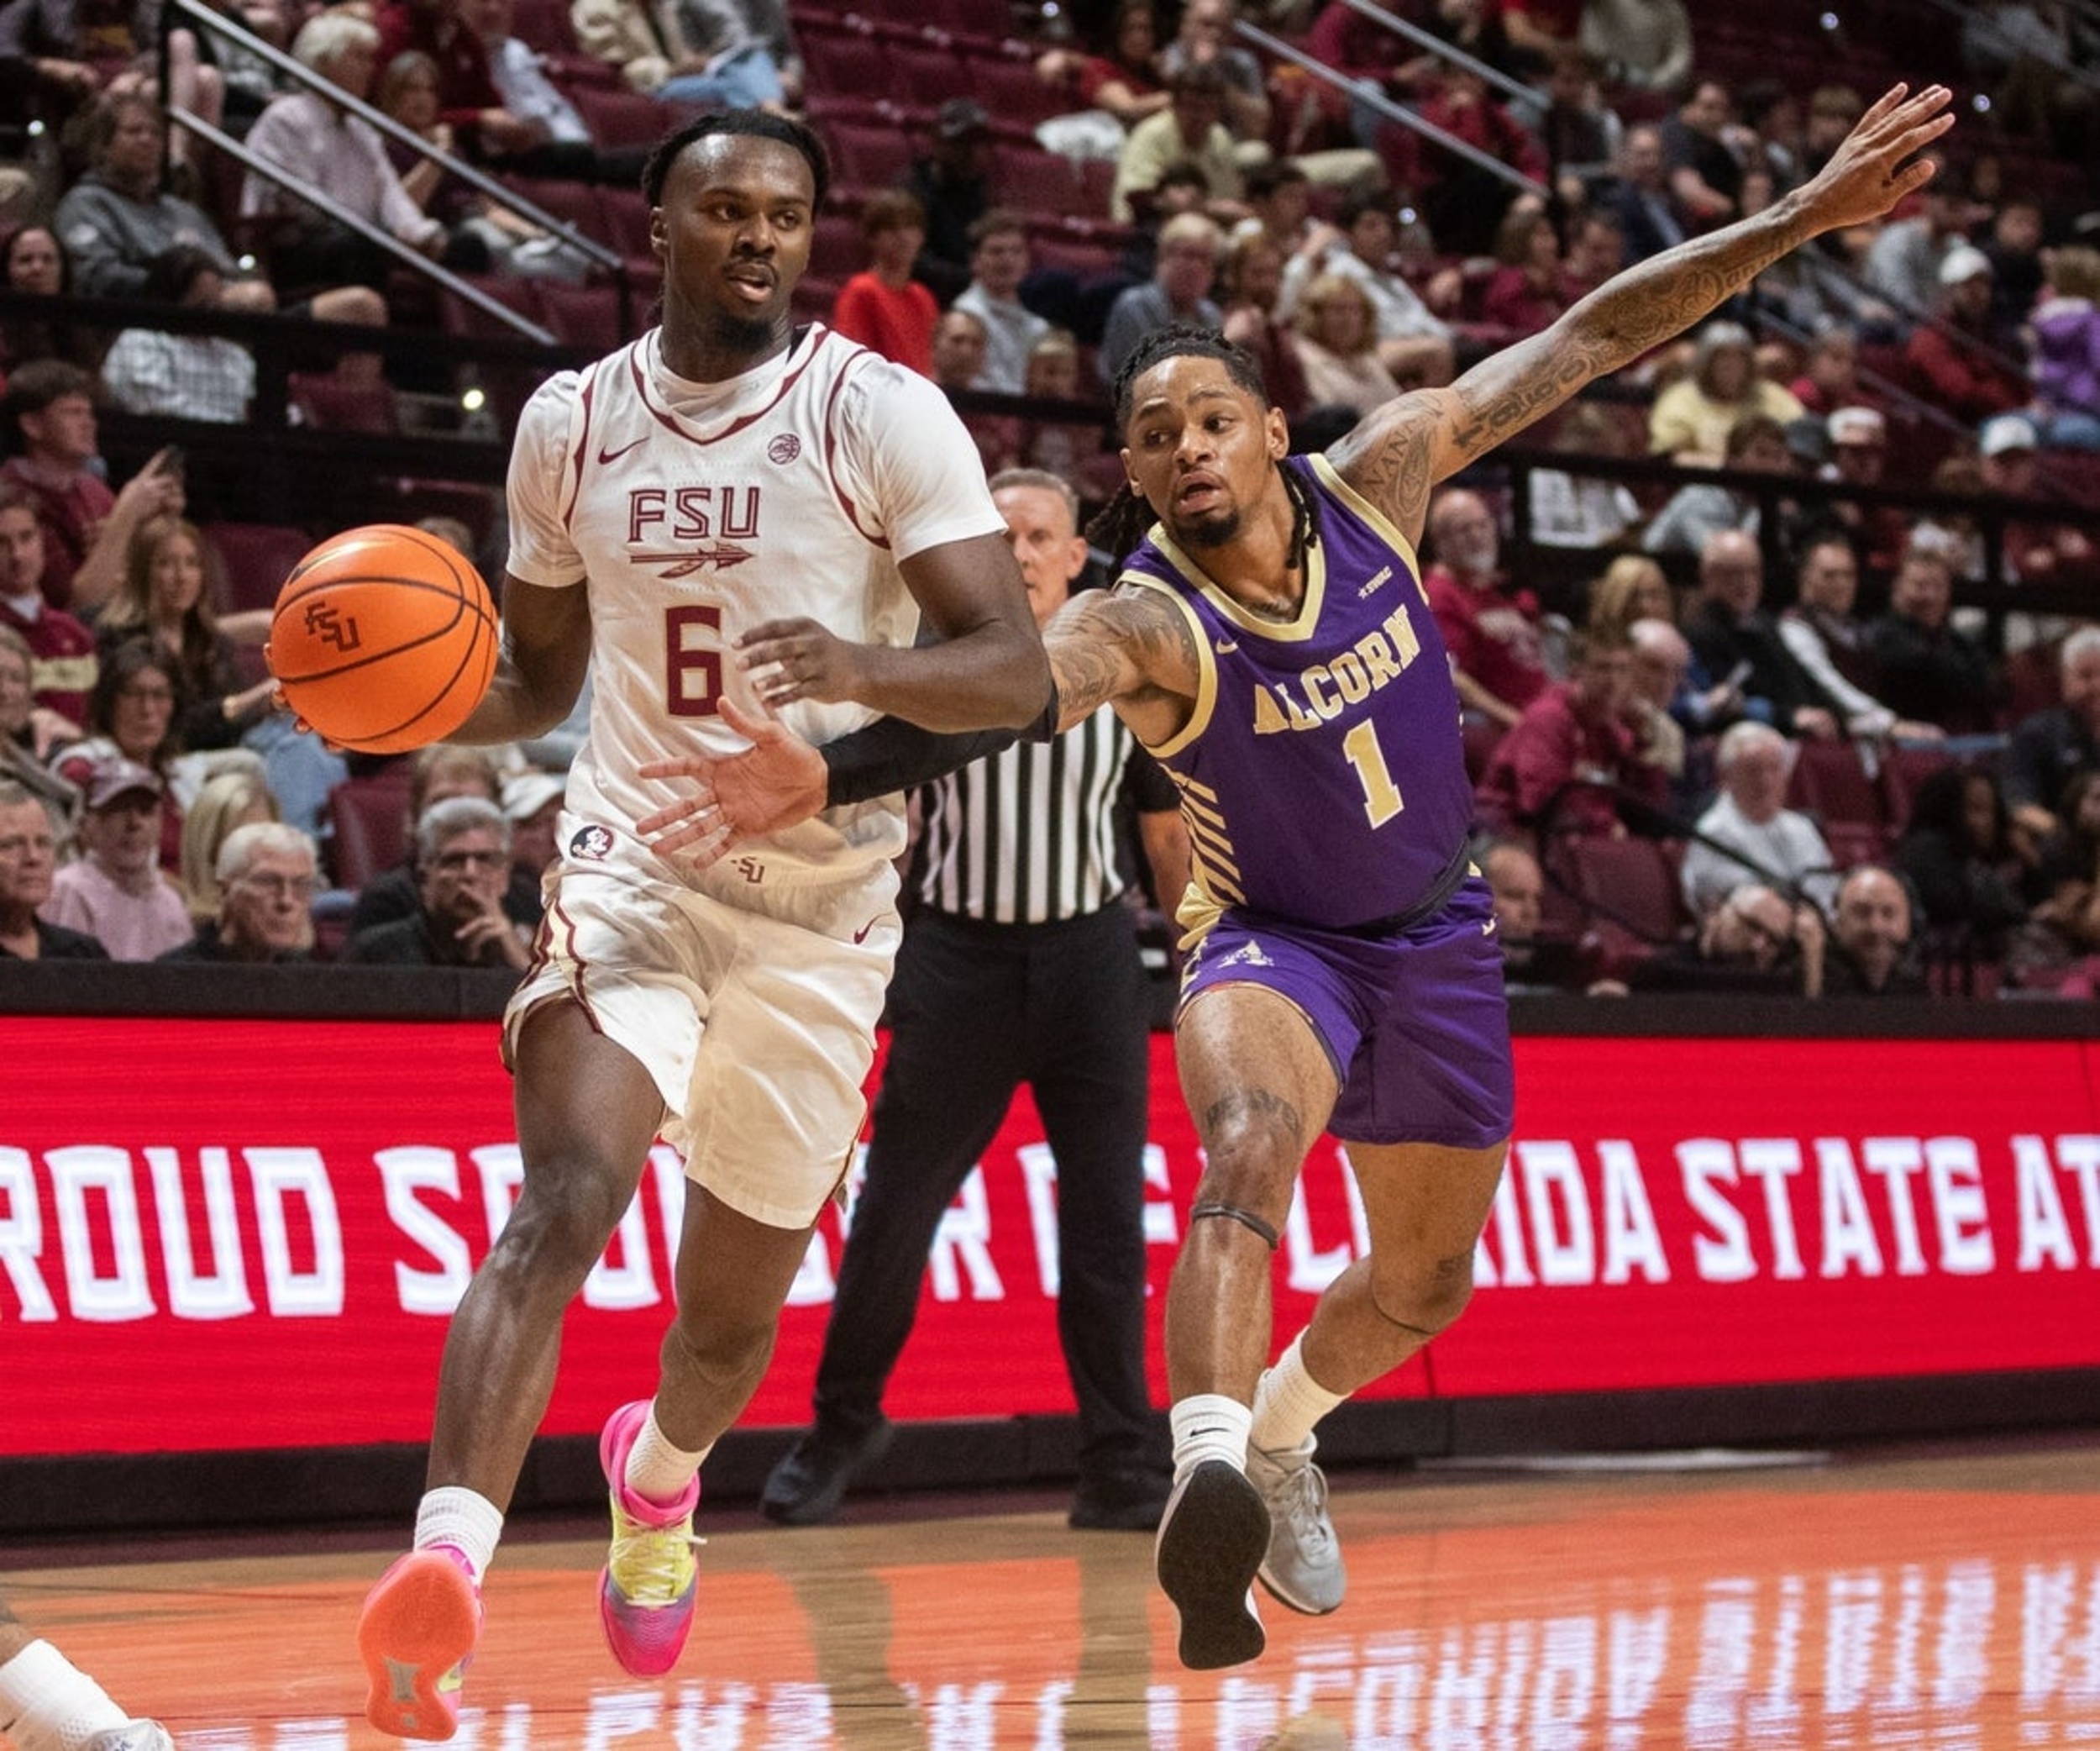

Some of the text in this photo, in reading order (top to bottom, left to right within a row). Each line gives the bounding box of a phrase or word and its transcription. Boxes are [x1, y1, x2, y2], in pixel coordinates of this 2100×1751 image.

[627, 486, 760, 543] FSU
[304, 601, 361, 652] FSU
[665, 605, 722, 717] 6
[1252, 603, 1421, 735] ALCORN
[1343, 718, 1404, 830] 1
[731, 856, 765, 883] SU
[1674, 1134, 1997, 1283] STATE
[2009, 1133, 2100, 1272] AT
